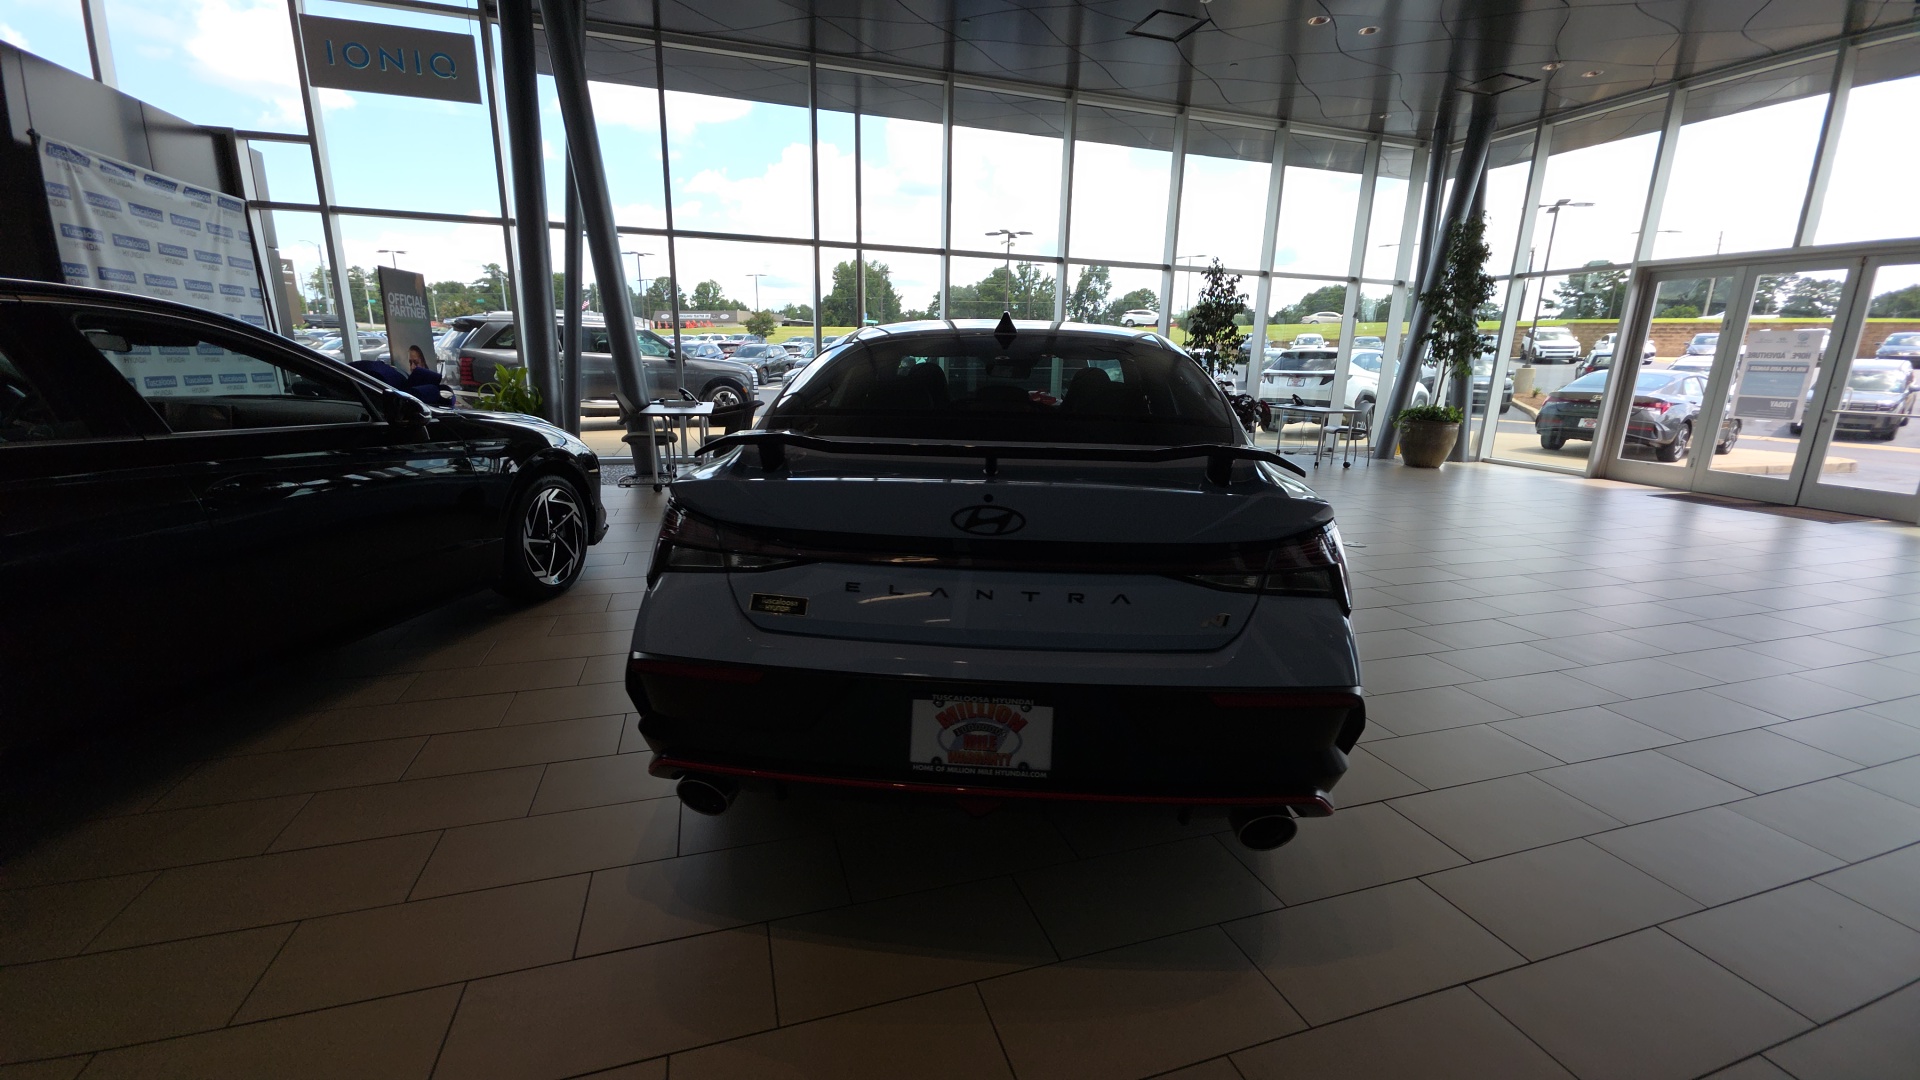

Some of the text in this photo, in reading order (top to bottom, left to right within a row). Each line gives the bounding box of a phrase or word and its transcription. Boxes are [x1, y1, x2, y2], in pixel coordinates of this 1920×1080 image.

[325, 39, 458, 80] IONIQ
[114, 234, 150, 251] Tuscaloosa
[101, 269, 135, 283] Tuscaloosa
[145, 275, 177, 288] Tuscaloosa
[387, 291, 426, 309] OFFICIAL
[389, 304, 428, 320] PARTNER
[845, 581, 1131, 605] ELANTRA
[932, 694, 1035, 706] TUSCALOOSA HYUNDAI
[935, 701, 1029, 734] MILLION
[963, 734, 998, 752] MILE
[947, 750, 1013, 767] WARRANTY
[912, 764, 934, 772] HOME
[947, 766, 976, 775] MILLION
[977, 768, 994, 776] MILE
[994, 769, 1048, 779] HYUNDAI.COM
